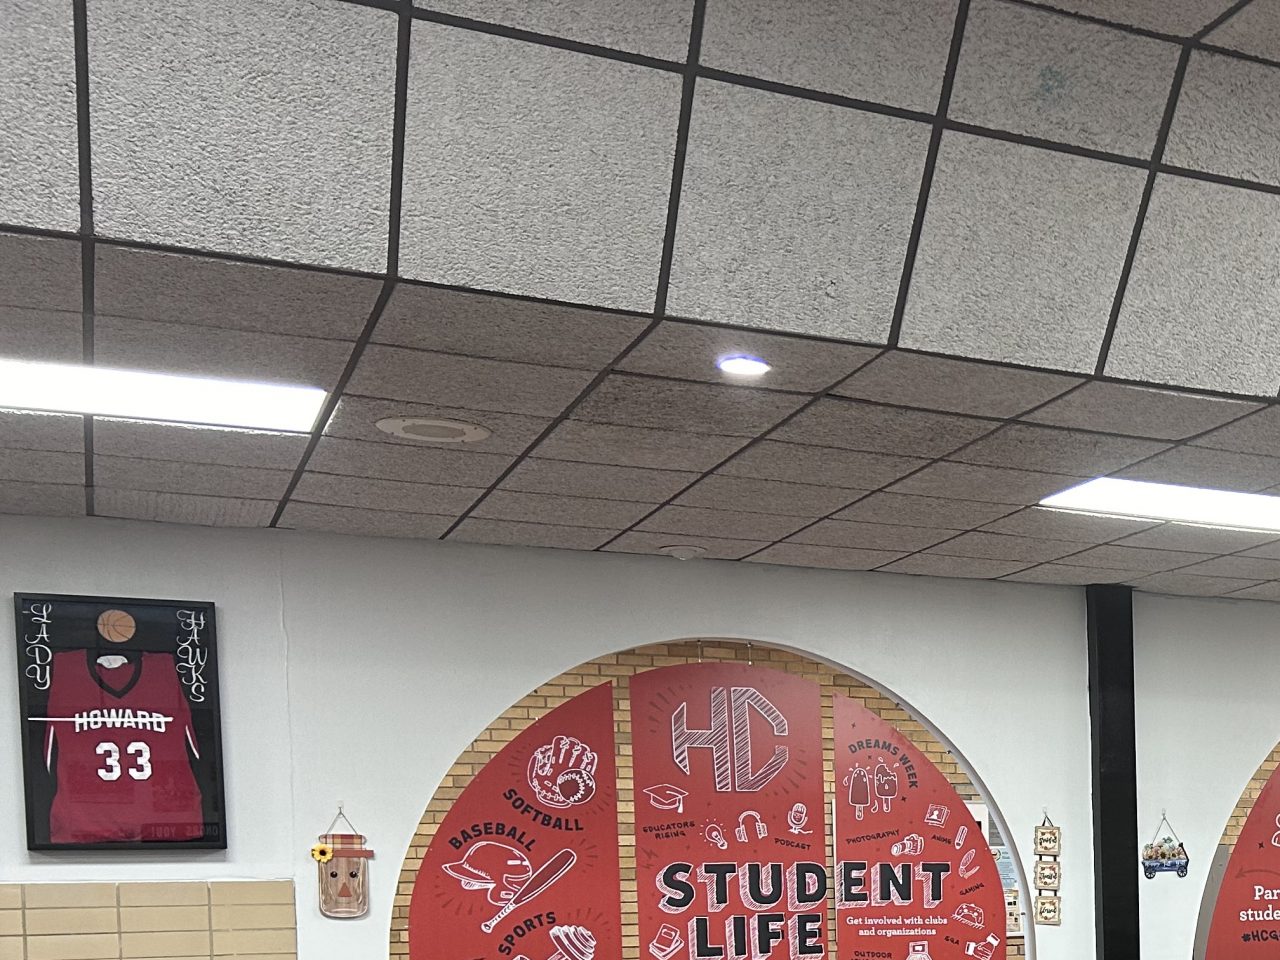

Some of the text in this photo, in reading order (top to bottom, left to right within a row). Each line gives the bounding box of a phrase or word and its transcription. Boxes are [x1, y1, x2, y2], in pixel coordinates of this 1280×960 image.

[74, 708, 166, 732] HOWARD
[95, 742, 152, 781] 33
[848, 739, 919, 789] DREAMS WEEK
[502, 788, 584, 832] SOFTBALL
[642, 820, 696, 833] EDUCATORS
[448, 822, 536, 852] BASEBALL
[655, 830, 686, 840] RISING
[846, 829, 900, 845] PHOTOGRAPHY
[774, 838, 811, 851] PODCAST
[656, 861, 951, 914] STUDENT
[959, 883, 985, 896] GAMING
[846, 915, 948, 925] Get involved with clubs
[498, 911, 557, 956] SPORTS
[858, 927, 937, 937] and organizations
[854, 950, 893, 959] OUTDOOR
